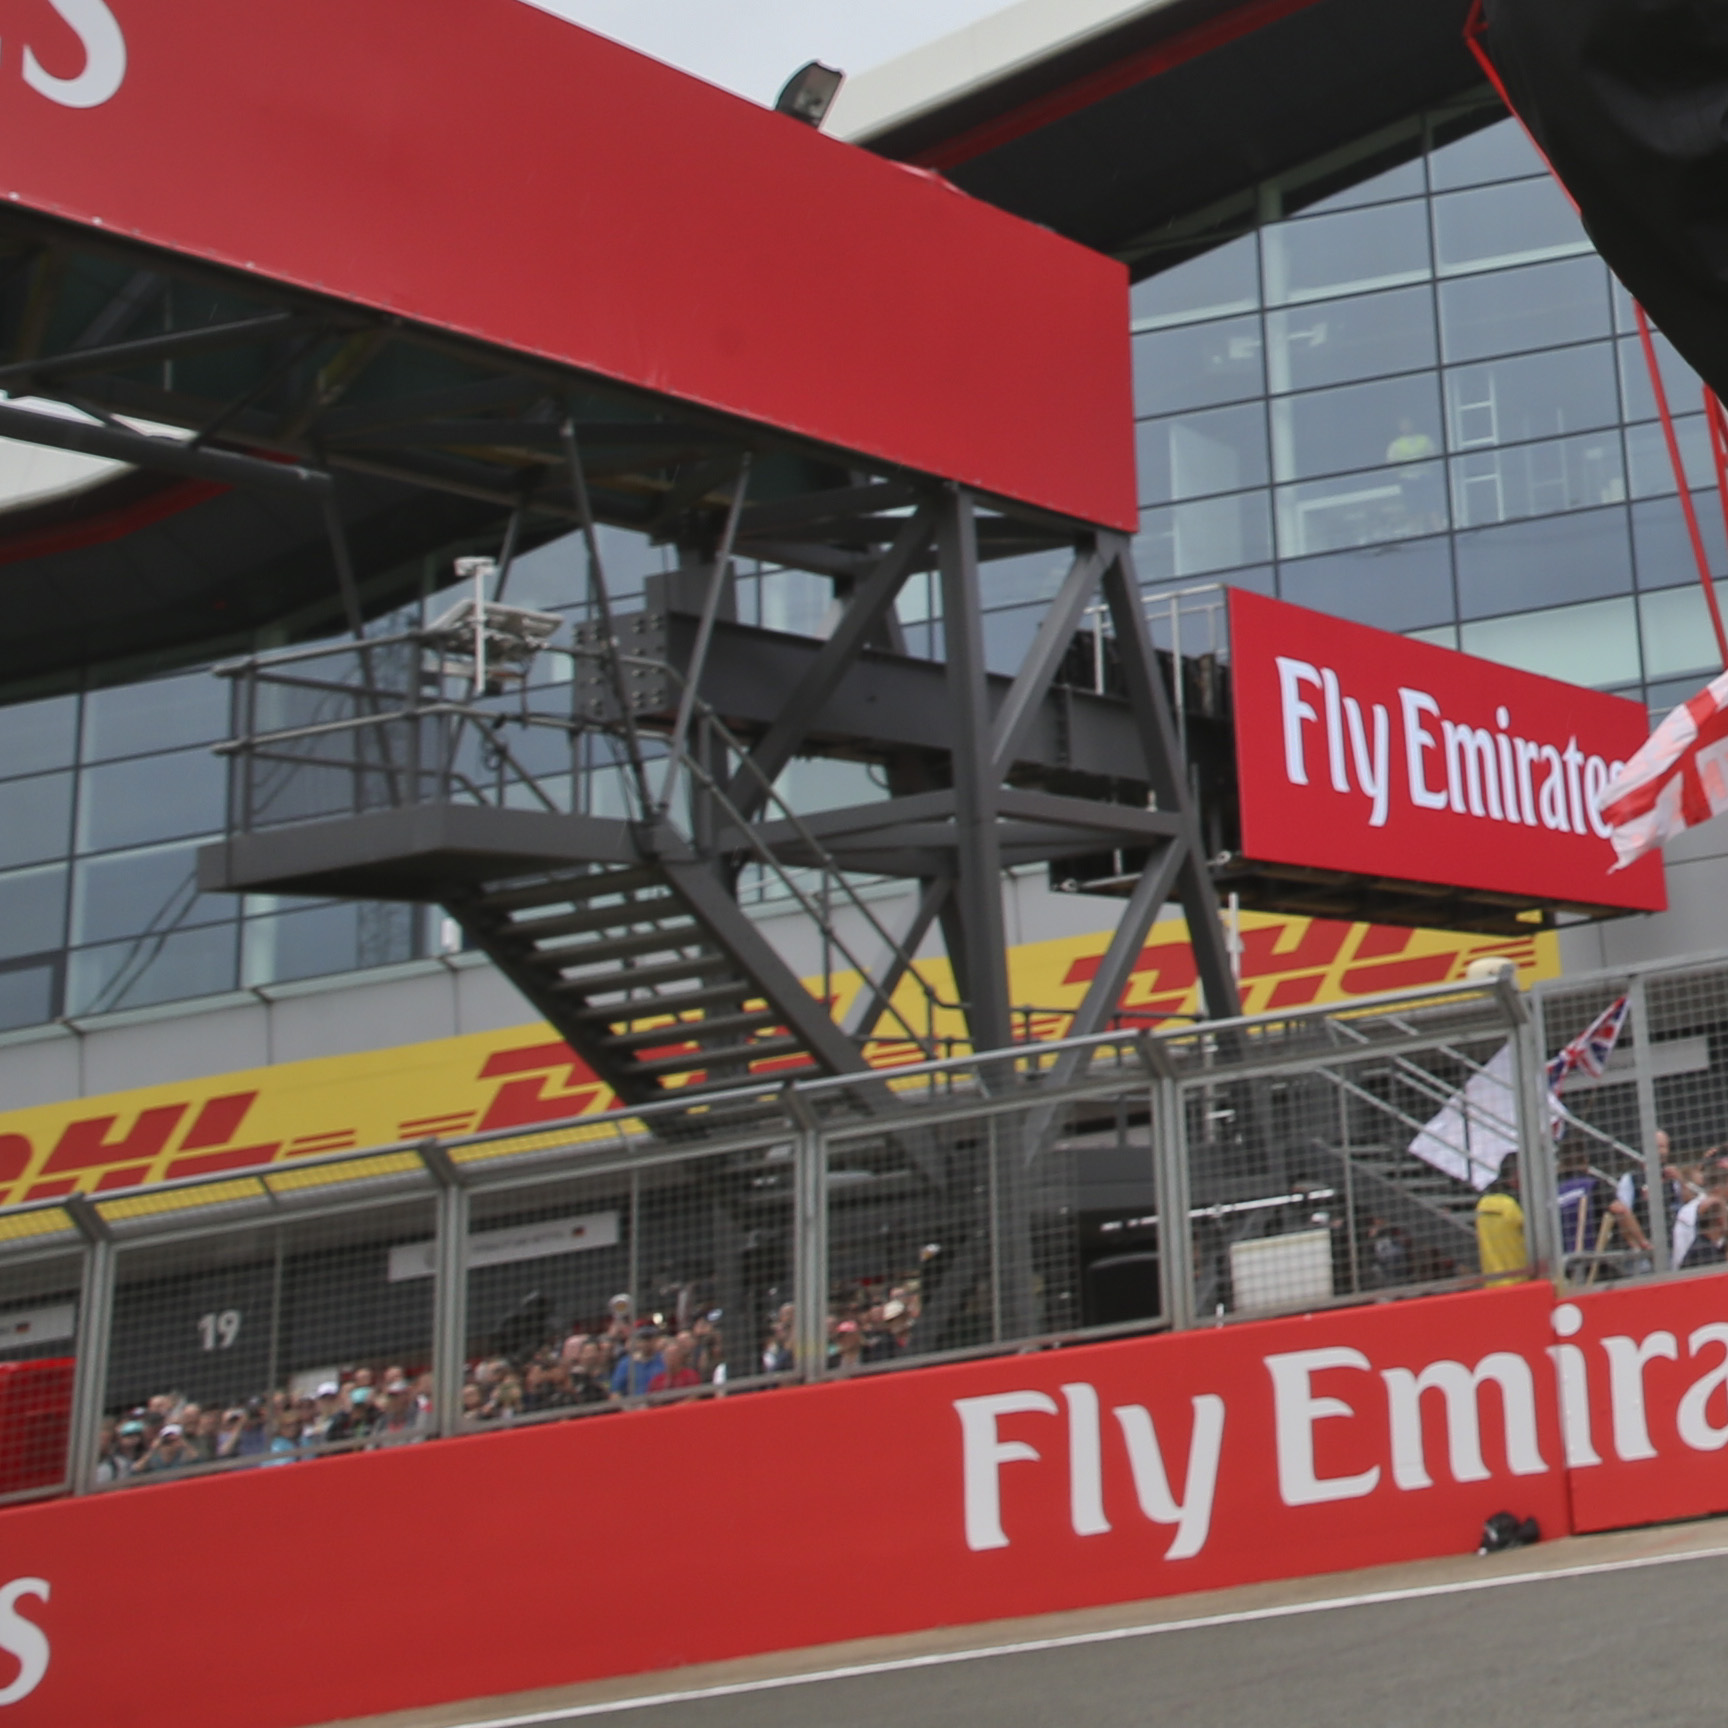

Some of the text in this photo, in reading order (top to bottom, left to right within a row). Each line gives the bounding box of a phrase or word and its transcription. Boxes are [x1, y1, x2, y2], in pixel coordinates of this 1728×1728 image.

[1275, 655, 1391, 827] Fly
[198, 1310, 242, 1352] 19
[953, 1382, 1226, 1561] Fly
